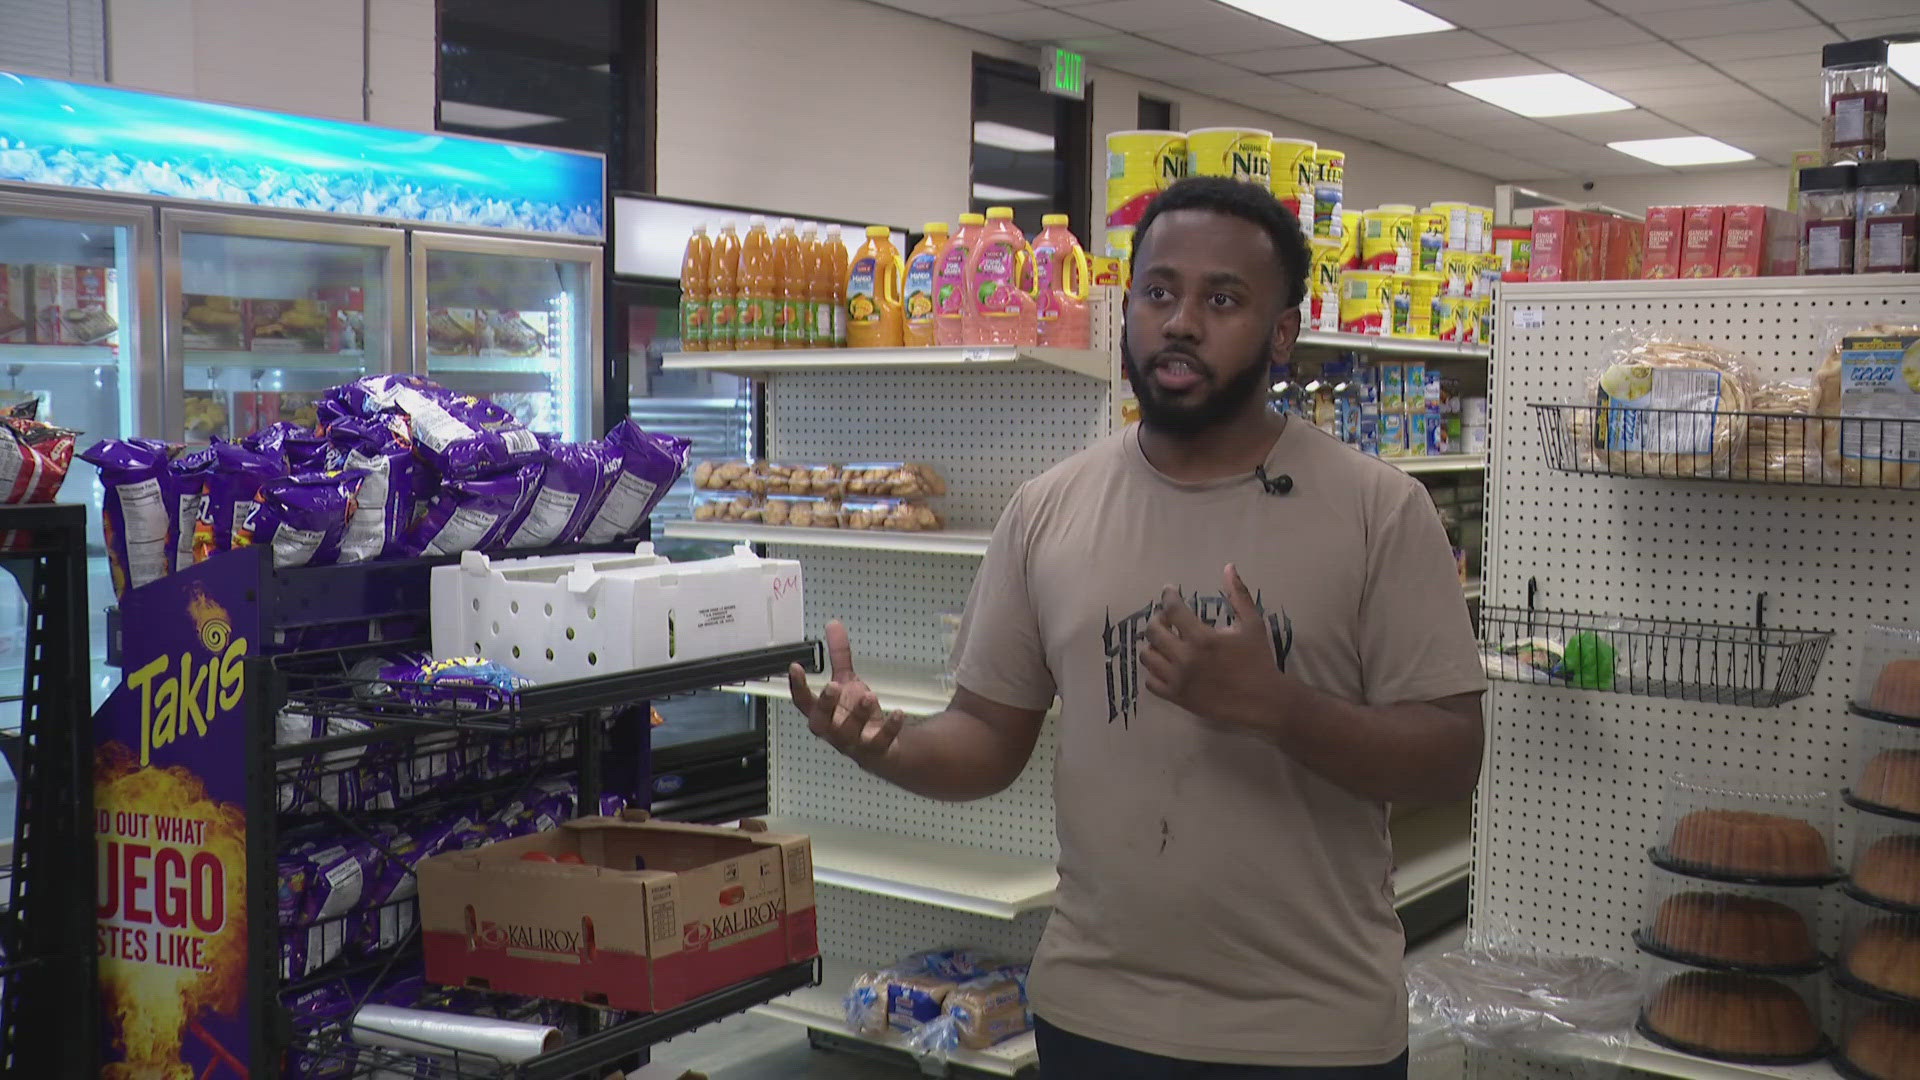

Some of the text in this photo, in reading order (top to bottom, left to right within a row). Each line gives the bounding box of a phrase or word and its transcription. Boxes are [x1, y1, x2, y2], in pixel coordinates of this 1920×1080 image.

[1162, 155, 1187, 178] NI
[1232, 152, 1269, 176] NID
[117, 813, 149, 838] OUT
[155, 816, 206, 846] WHAT
[712, 898, 782, 940] KALIROY
[508, 924, 579, 952] KALIROY
